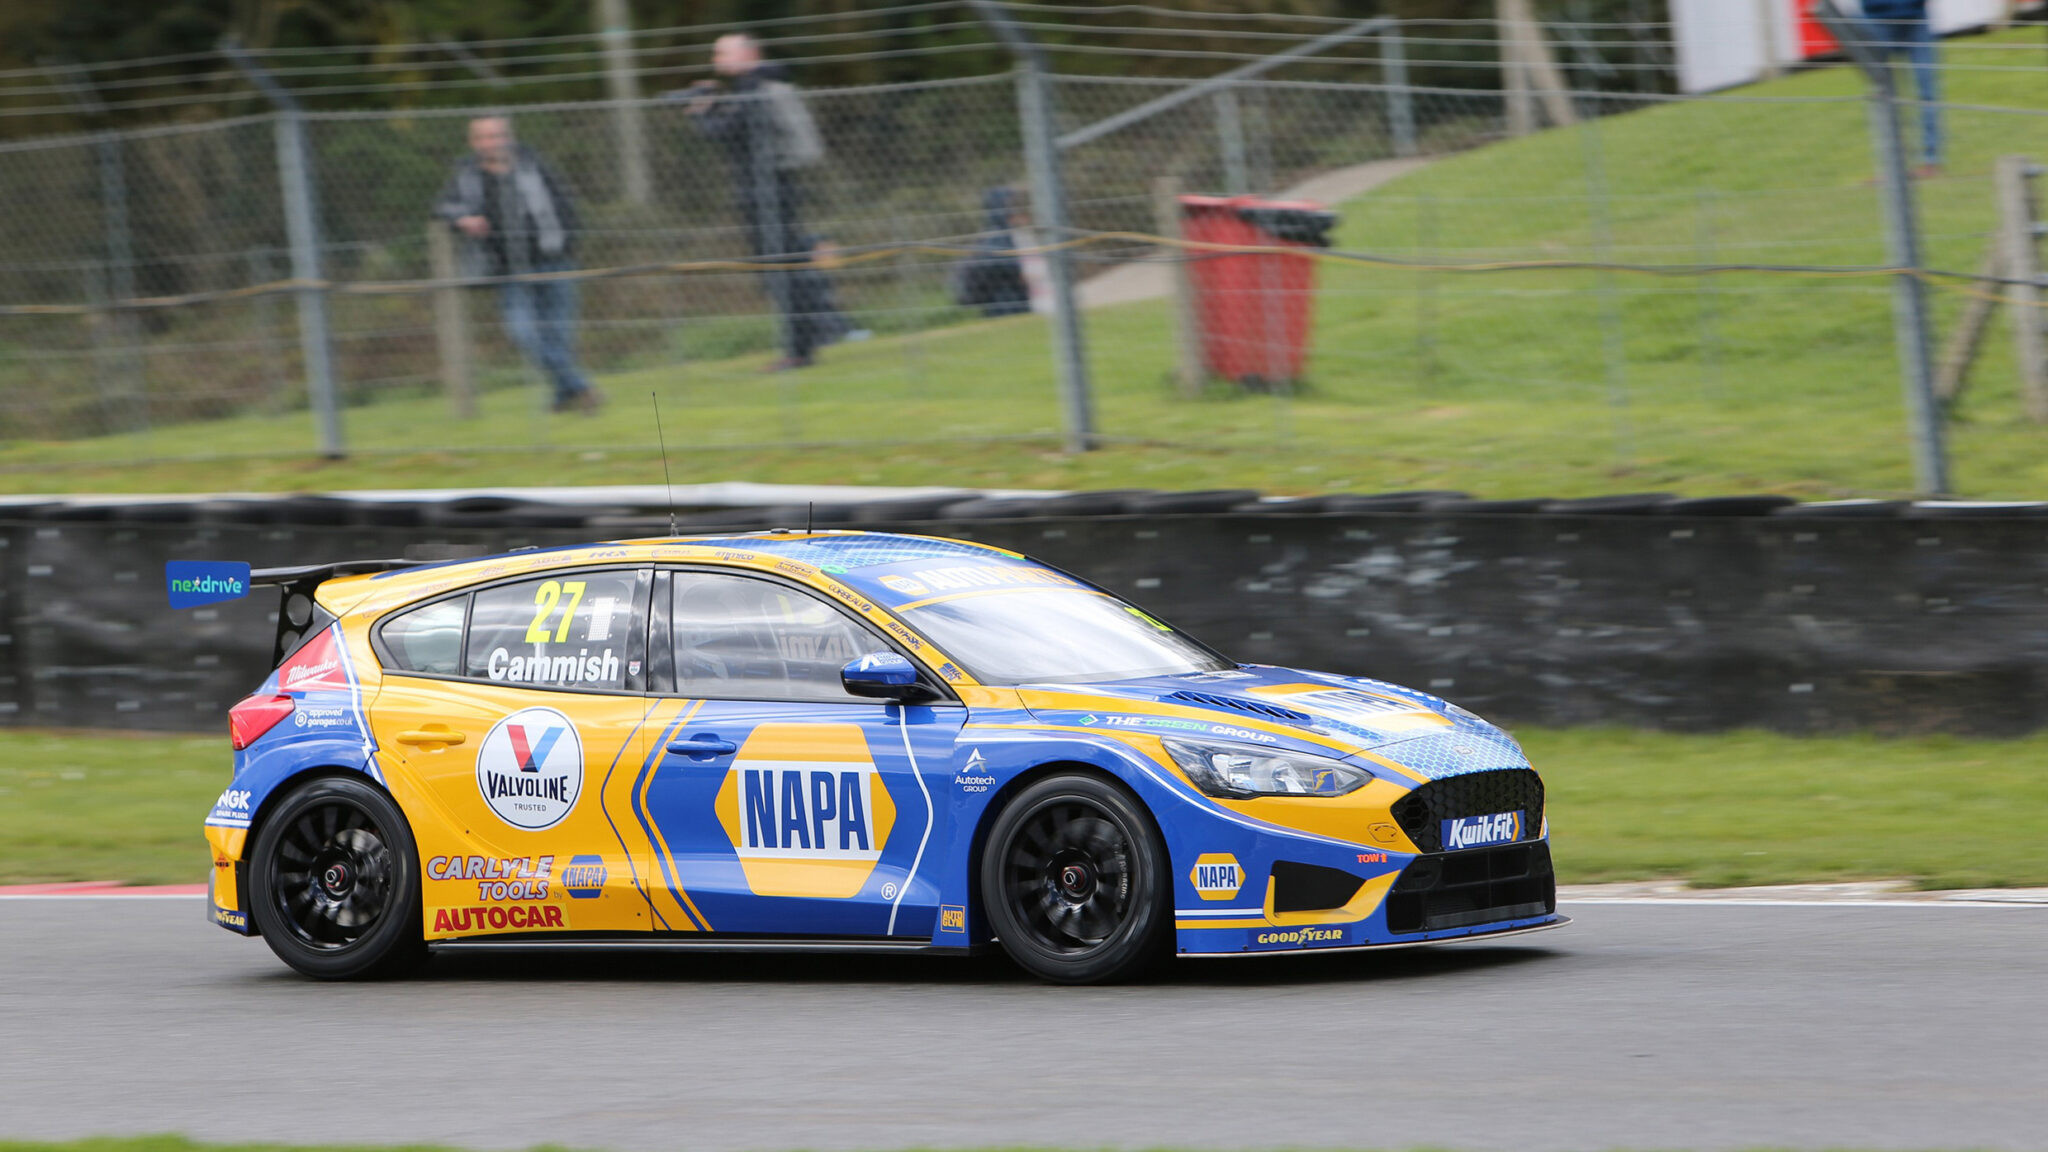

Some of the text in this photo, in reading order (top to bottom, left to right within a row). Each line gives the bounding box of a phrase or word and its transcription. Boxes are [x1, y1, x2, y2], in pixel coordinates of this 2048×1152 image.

[172, 575, 242, 594] nexdrive
[525, 580, 587, 643] 27
[286, 659, 338, 684] Milwaukee
[488, 647, 619, 682] Cammish
[308, 707, 344, 718] approved
[1105, 715, 1277, 744] THE GREEN GROUP
[487, 770, 569, 804] VALVOLINE
[954, 775, 996, 785] Autotech
[963, 785, 988, 793] GROUP
[217, 788, 252, 811] NGK
[514, 803, 547, 812] TRUSTED
[744, 769, 870, 851] NAPA
[426, 855, 555, 881] CARLYLE
[1356, 853, 1380, 863] TOW
[568, 866, 601, 887] NAPA
[1199, 866, 1237, 888] NAPA
[479, 880, 549, 901] TOOLS
[433, 905, 565, 932] AUTOCAR
[943, 910, 963, 920] AUTO
[1257, 927, 1343, 945] GOODYEAR
